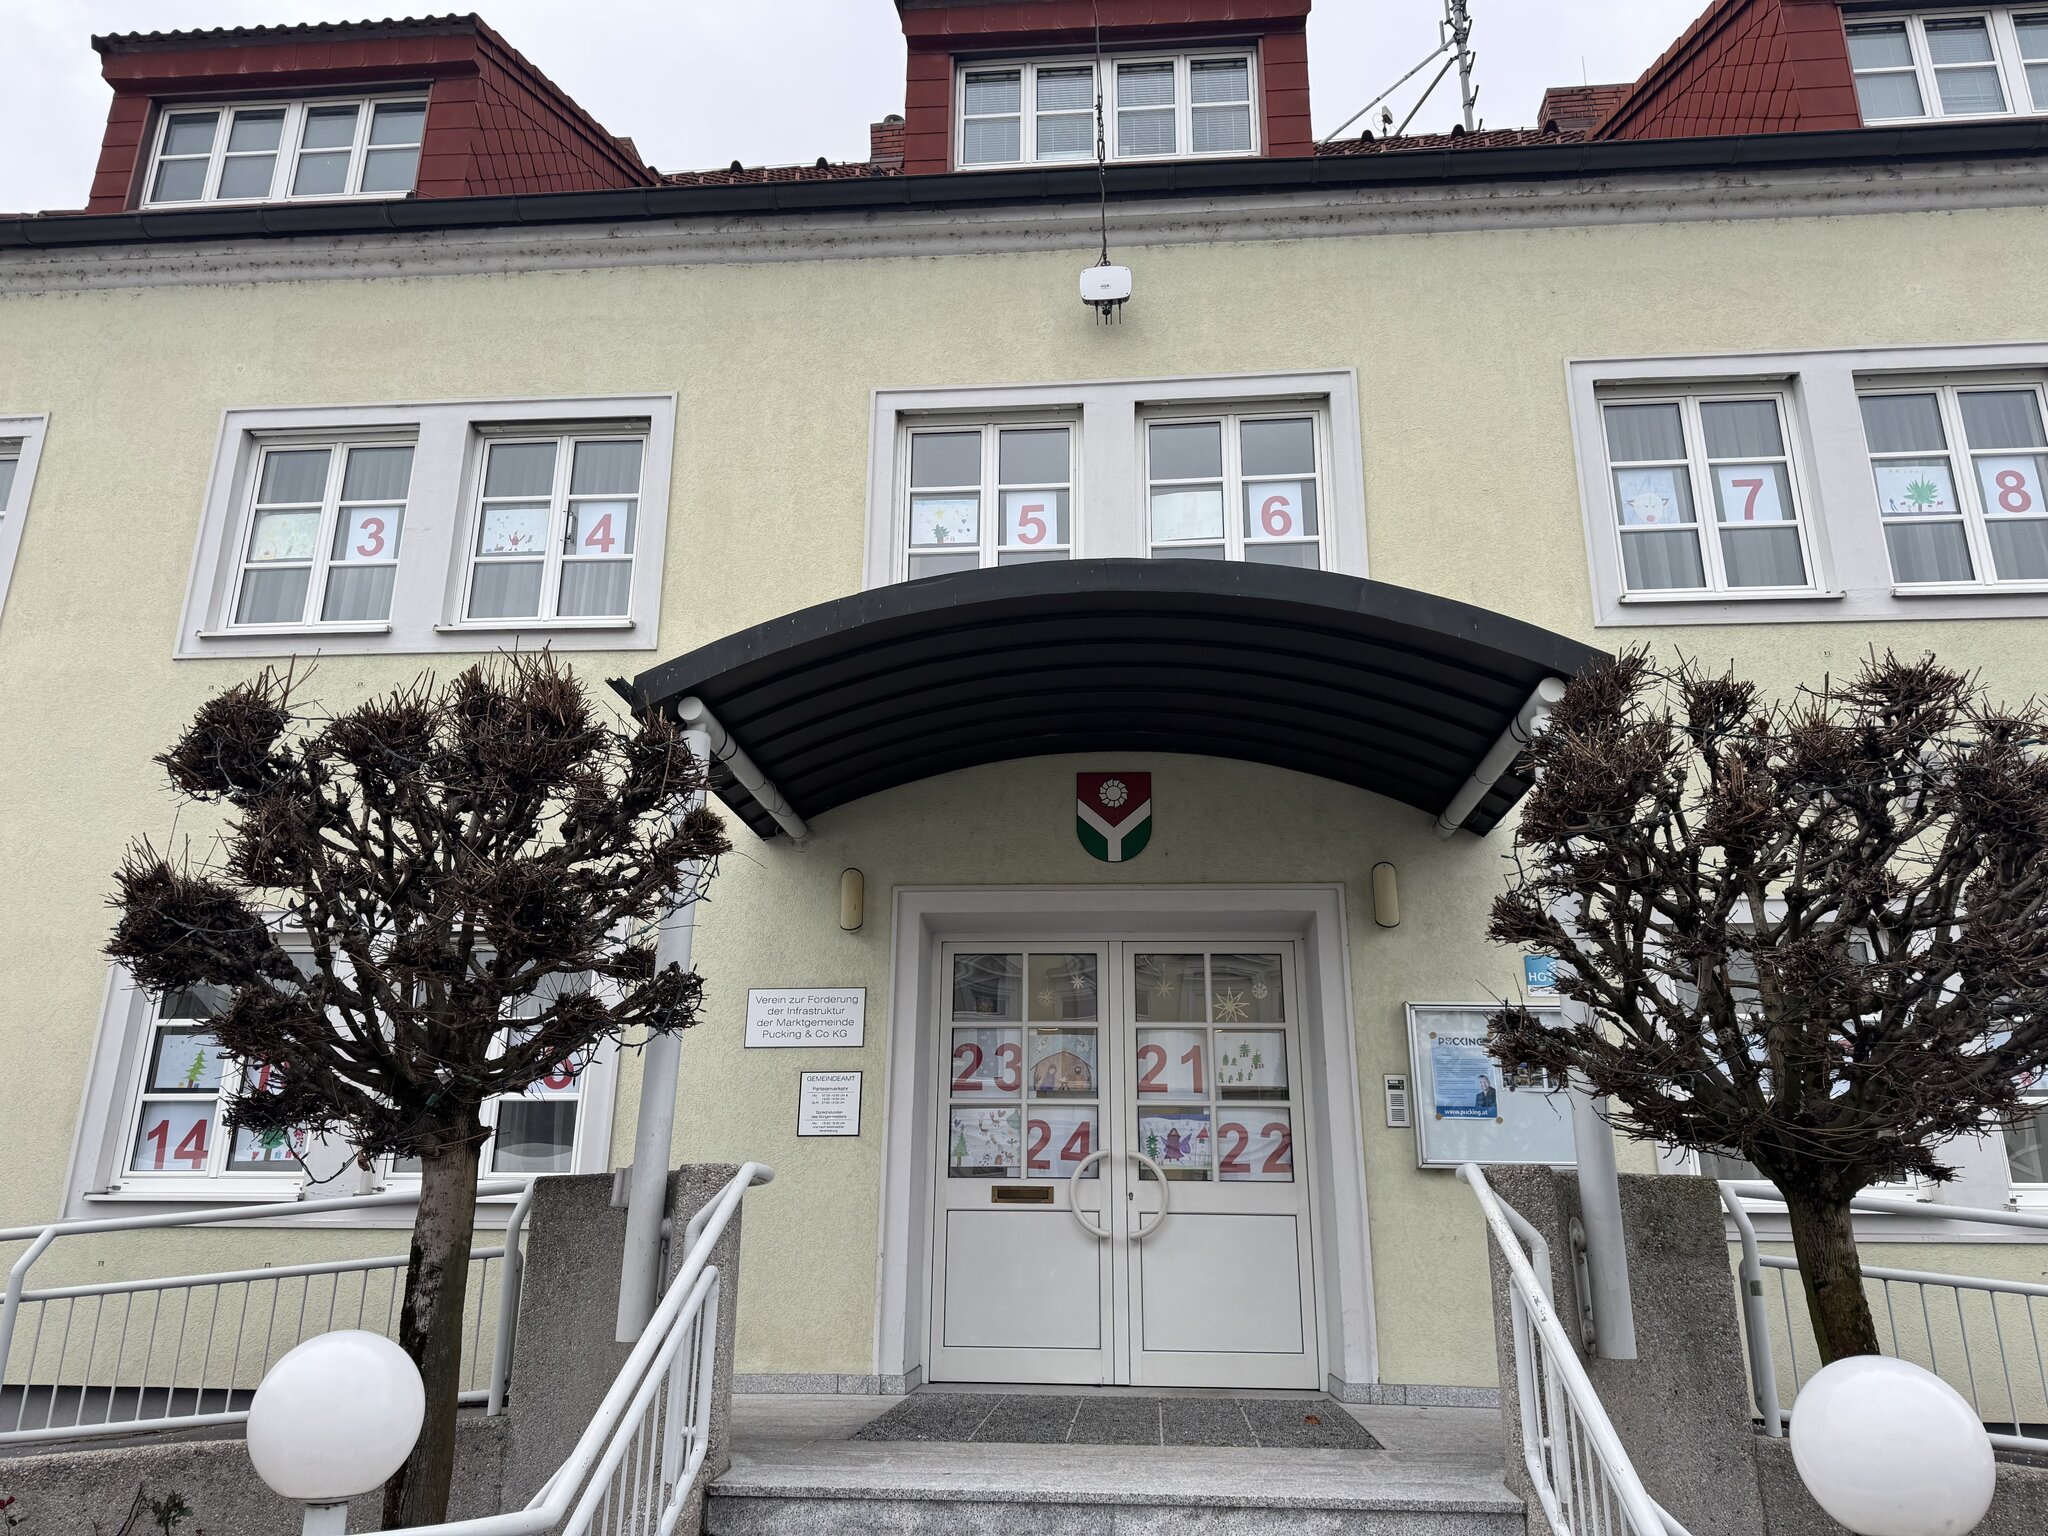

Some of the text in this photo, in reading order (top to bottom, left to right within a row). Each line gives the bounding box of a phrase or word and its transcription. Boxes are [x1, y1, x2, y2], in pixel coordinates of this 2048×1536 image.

[1731, 478, 1765, 521] 7
[1995, 469, 2033, 513] 8
[584, 512, 616, 553] 4
[1017, 503, 1047, 545] 5
[1260, 494, 1293, 537] 6
[356, 517, 385, 557] 3
[755, 996, 786, 1004] Verein
[767, 1007, 845, 1015] der Infrastruktur
[756, 1018, 855, 1028] der Marktgemeinde
[762, 1029, 848, 1039] Pucking & Co KG
[951, 1042, 1023, 1092] 23
[1137, 1043, 1204, 1094] 21
[1444, 1109, 1488, 1117] www.pucking.at
[146, 1118, 209, 1171] 14
[1026, 1118, 1092, 1173] 24
[1217, 1122, 1292, 1174] 22
